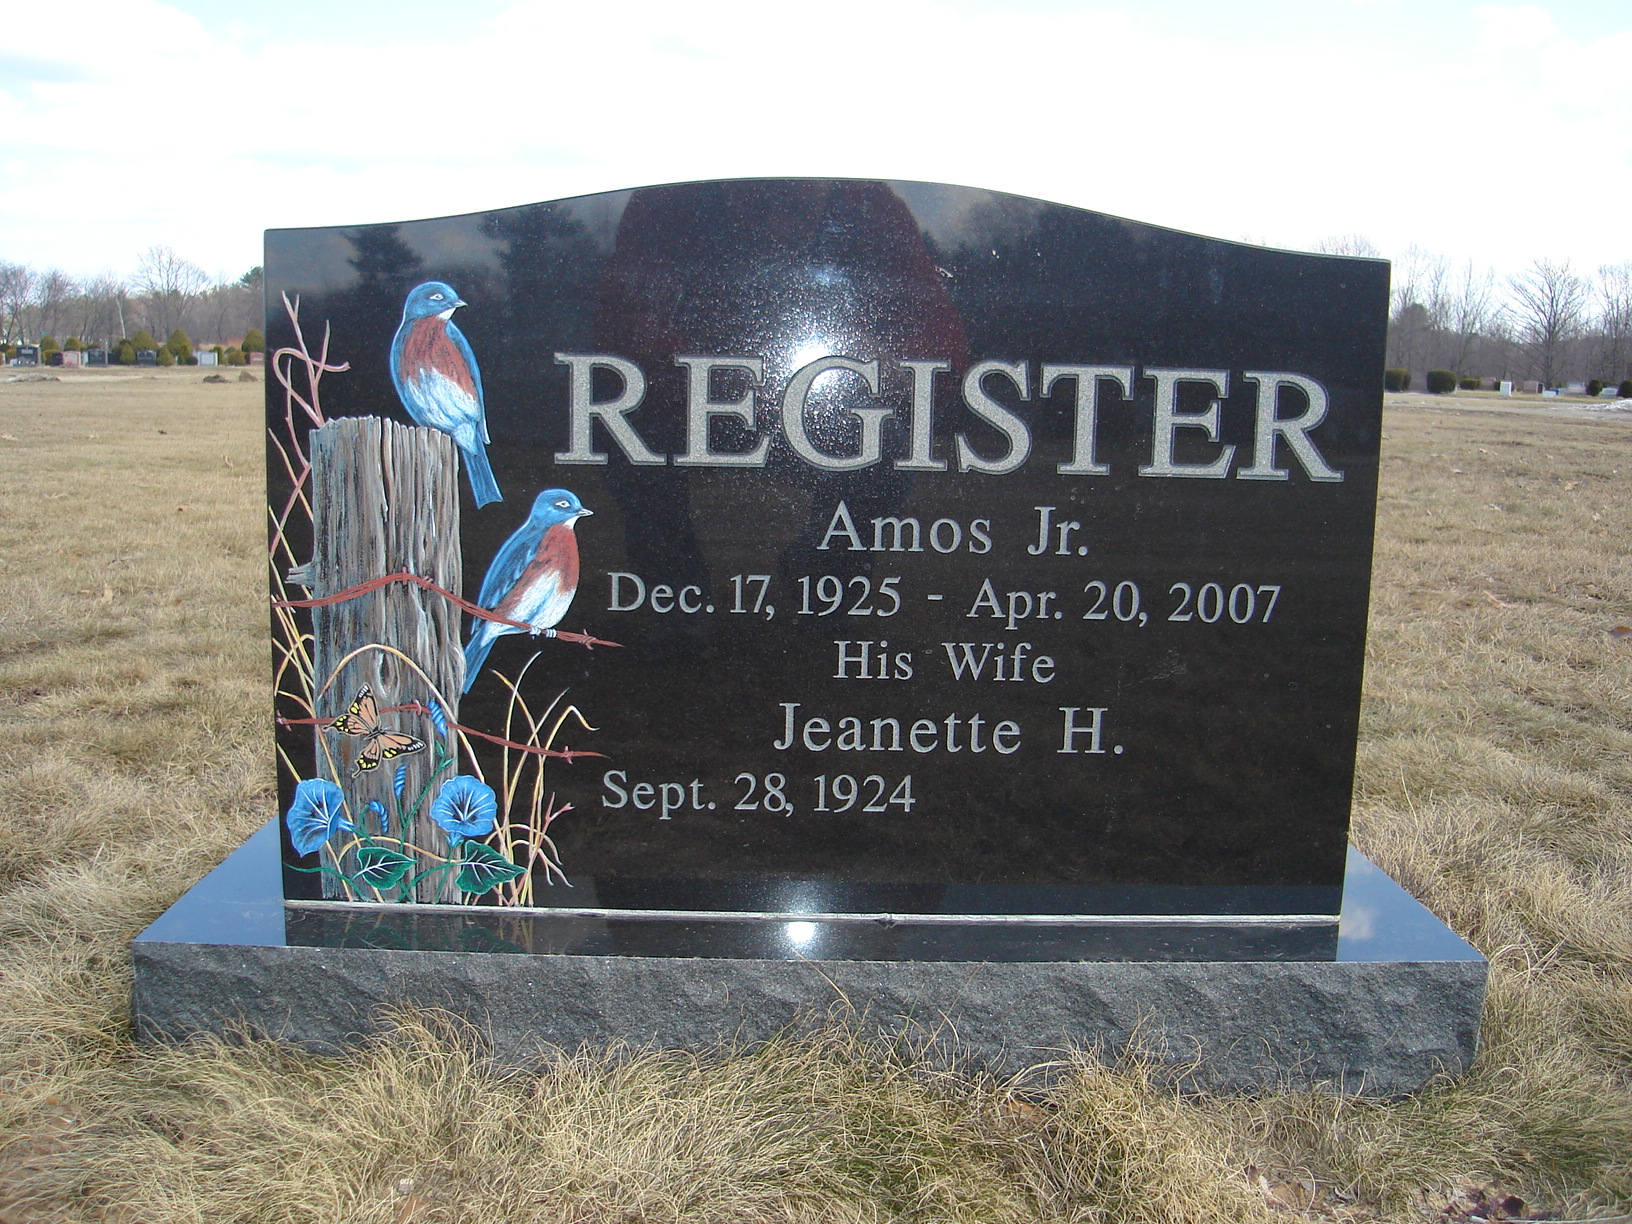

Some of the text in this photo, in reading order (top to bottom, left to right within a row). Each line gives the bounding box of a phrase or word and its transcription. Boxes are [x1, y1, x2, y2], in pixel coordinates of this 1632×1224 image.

[553, 351, 1345, 483] REGISTER
[817, 502, 1088, 557] Amos Jr.
[607, 571, 715, 614] Dec.
[729, 574, 775, 622] 17,
[797, 575, 902, 617] 1925
[966, 577, 1063, 631] Apr.
[1082, 580, 1149, 629] 20,
[1167, 582, 1281, 624] 2007
[833, 640, 1056, 684] His Wife
[773, 702, 1125, 755] Jeanette H.
[601, 769, 916, 821] Sept. 28, 1924
